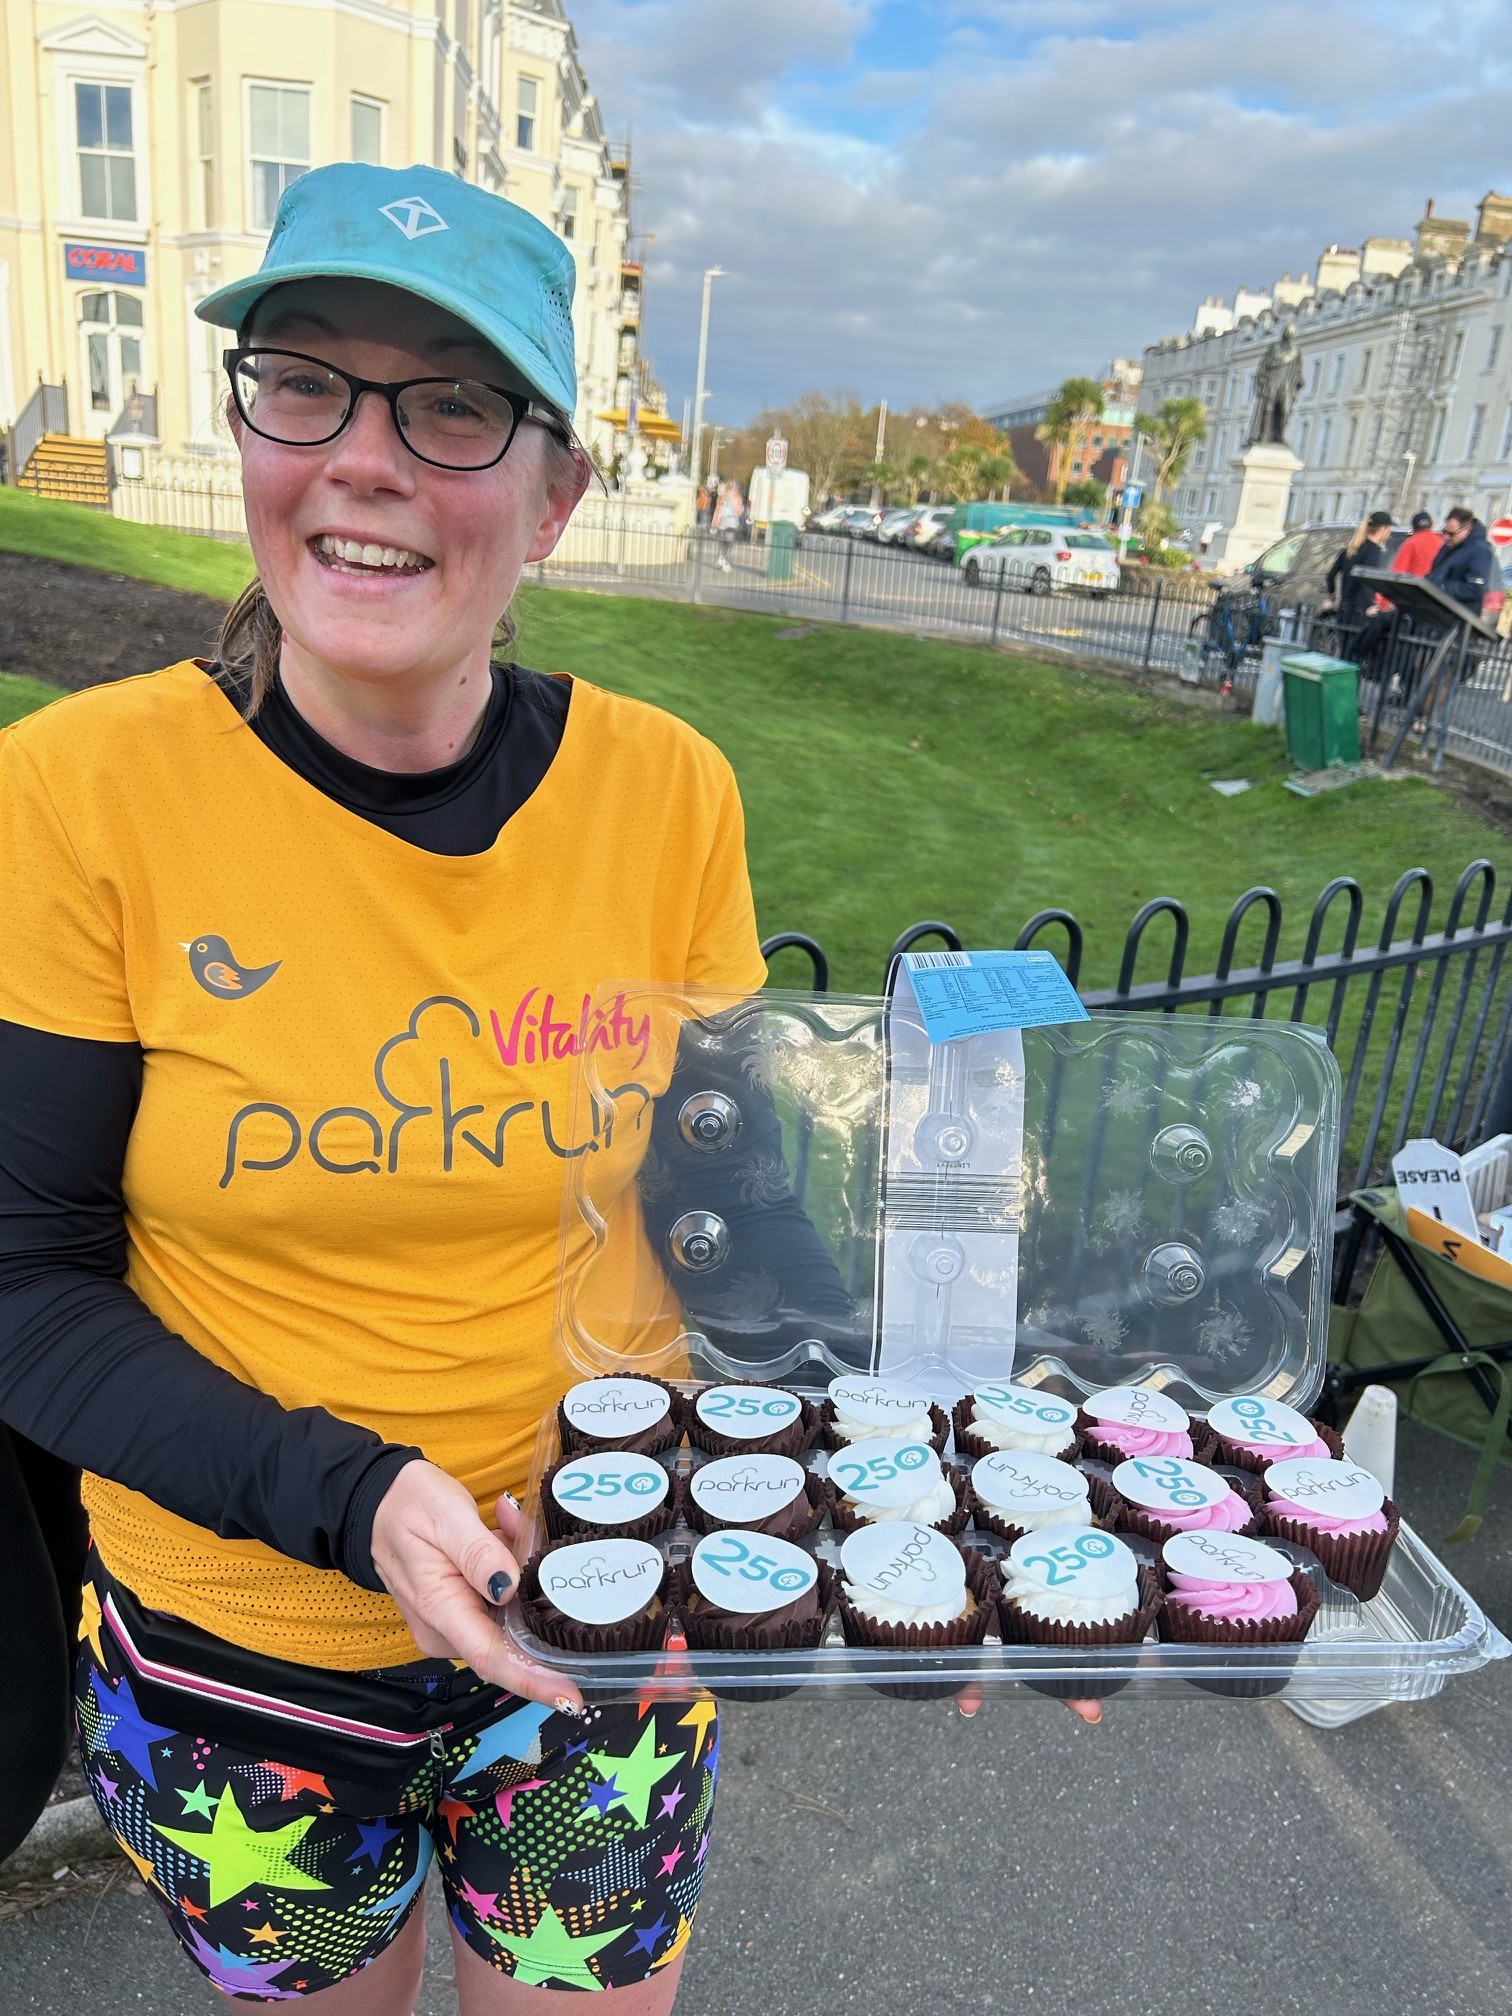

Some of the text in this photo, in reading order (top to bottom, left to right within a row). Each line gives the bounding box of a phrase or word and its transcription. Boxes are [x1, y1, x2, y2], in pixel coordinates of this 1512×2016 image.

[69, 248, 139, 272] CORAL
[489, 986, 652, 1070] Vitality
[219, 996, 650, 1189] parkrun
[1397, 1169, 1461, 1184] PLEASE
[570, 1390, 665, 1415] parkrun
[701, 1394, 796, 1417] 250
[834, 1387, 927, 1408] parkrun
[976, 1386, 1070, 1424] 250
[1231, 1399, 1298, 1443] 250
[557, 1472, 662, 1501] 250
[697, 1467, 800, 1493] parkrun
[837, 1445, 930, 1491] 250
[987, 1457, 1082, 1500] parkrun
[1132, 1460, 1207, 1506] 250
[1282, 1471, 1371, 1499] parkrun
[550, 1556, 660, 1591] parkrun
[701, 1537, 810, 1592] 250
[867, 1526, 937, 1591] parkrun
[1023, 1534, 1114, 1586] 250
